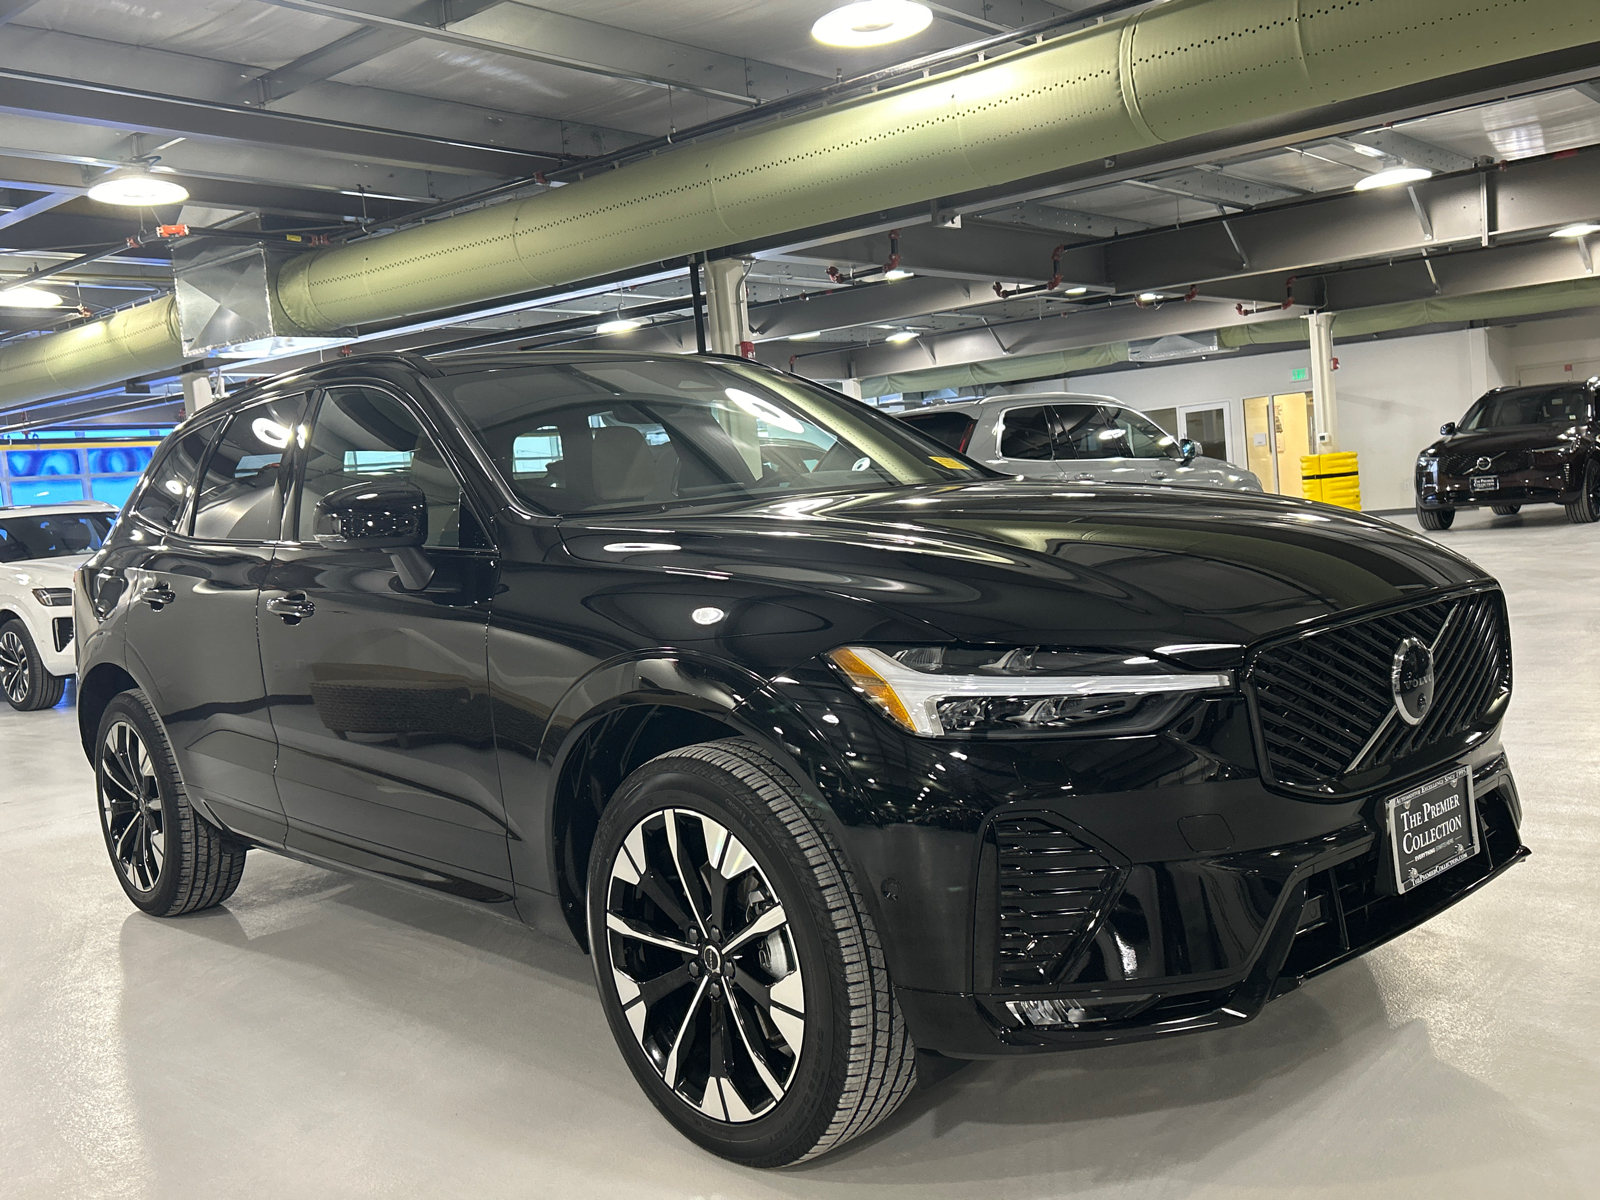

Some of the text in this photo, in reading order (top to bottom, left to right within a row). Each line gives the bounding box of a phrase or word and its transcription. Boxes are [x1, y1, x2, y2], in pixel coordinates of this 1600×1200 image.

[1400, 794, 1460, 832] THE PREMIER
[1402, 814, 1463, 855] COLLECTION
